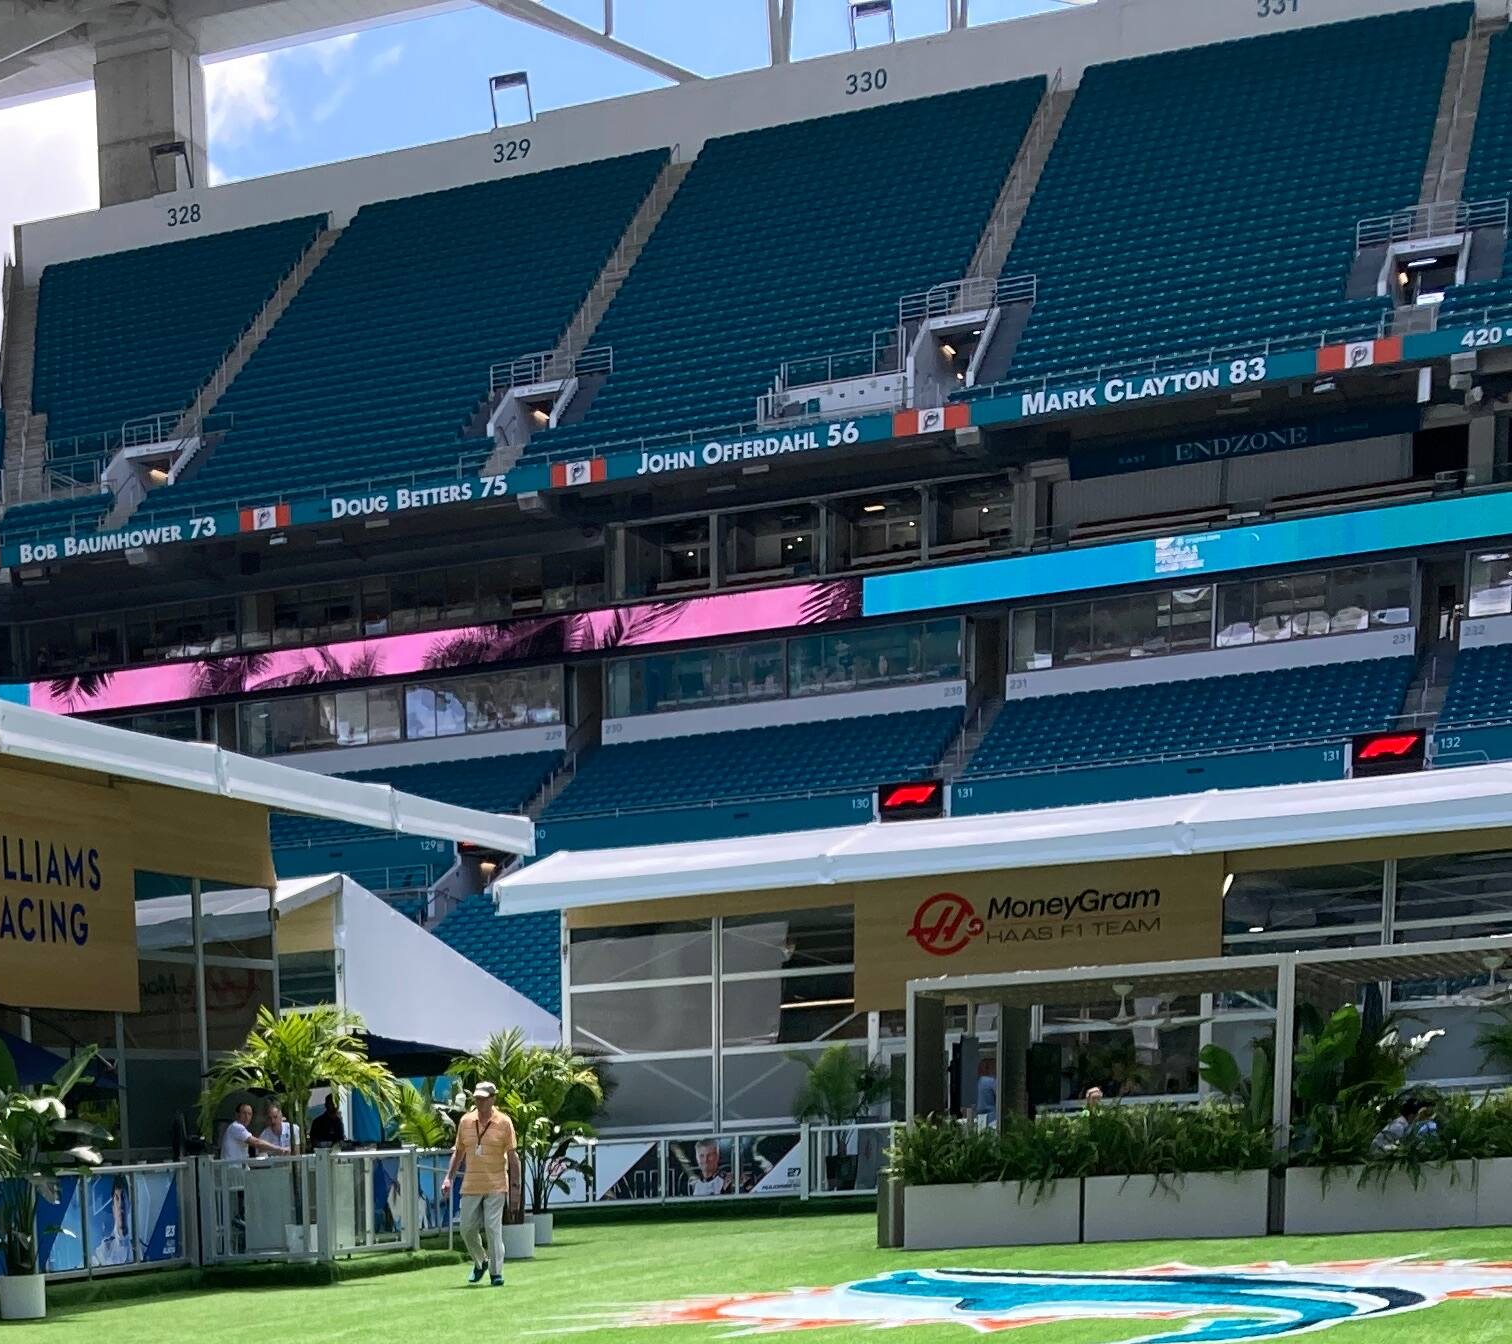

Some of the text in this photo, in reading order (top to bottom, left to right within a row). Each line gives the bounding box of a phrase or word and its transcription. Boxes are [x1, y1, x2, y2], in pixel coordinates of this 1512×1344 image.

[845, 68, 888, 95] 330
[492, 138, 531, 163] 329
[167, 203, 202, 227] 328
[1021, 356, 1267, 417] MARK CLAYTON 83
[636, 421, 859, 475] JOHN OFFERDAHL 56
[1175, 426, 1308, 461] ENDZONE
[331, 475, 508, 519] DOUG BETTERS 75
[20, 517, 216, 564] BOB BAUMHOWER 73
[1392, 633, 1412, 645] 231
[1441, 736, 1462, 749] 132
[1323, 750, 1340, 762] 131
[852, 798, 870, 809] 130
[957, 787, 974, 798] 131
[420, 840, 437, 851] 129
[988, 888, 1161, 920] MoneyGram
[987, 917, 1161, 944] HAAS F1 TEAM
